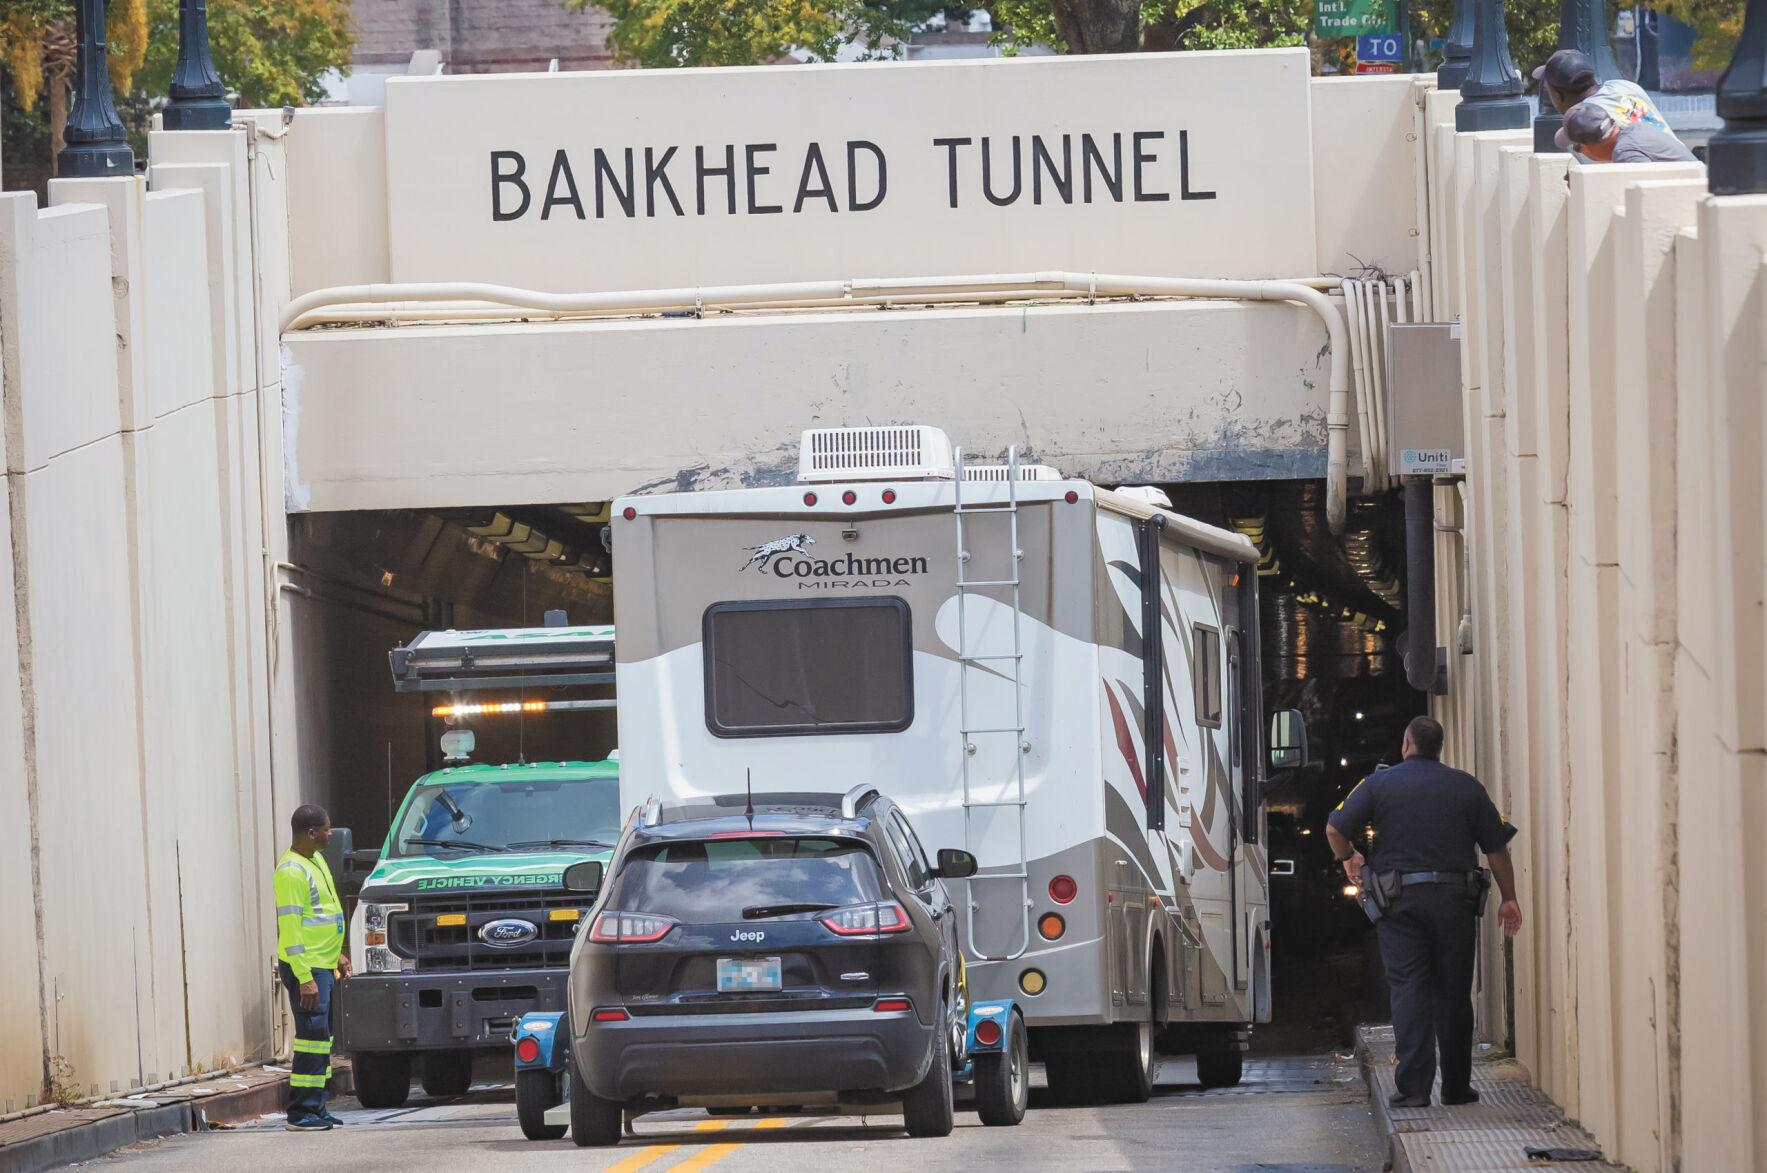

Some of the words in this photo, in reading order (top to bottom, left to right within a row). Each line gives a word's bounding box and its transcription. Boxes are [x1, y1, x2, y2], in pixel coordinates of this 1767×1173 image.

[1320, 15, 1357, 27] Trade
[1370, 39, 1397, 56] TO
[491, 141, 887, 222] BANKHEAD
[934, 130, 1217, 209] TUNNEL
[1418, 452, 1448, 462] Uniti
[773, 552, 928, 578] Coachmen
[798, 579, 911, 590] MIRADA
[494, 926, 521, 938] Ford
[730, 929, 765, 943] Jeep
